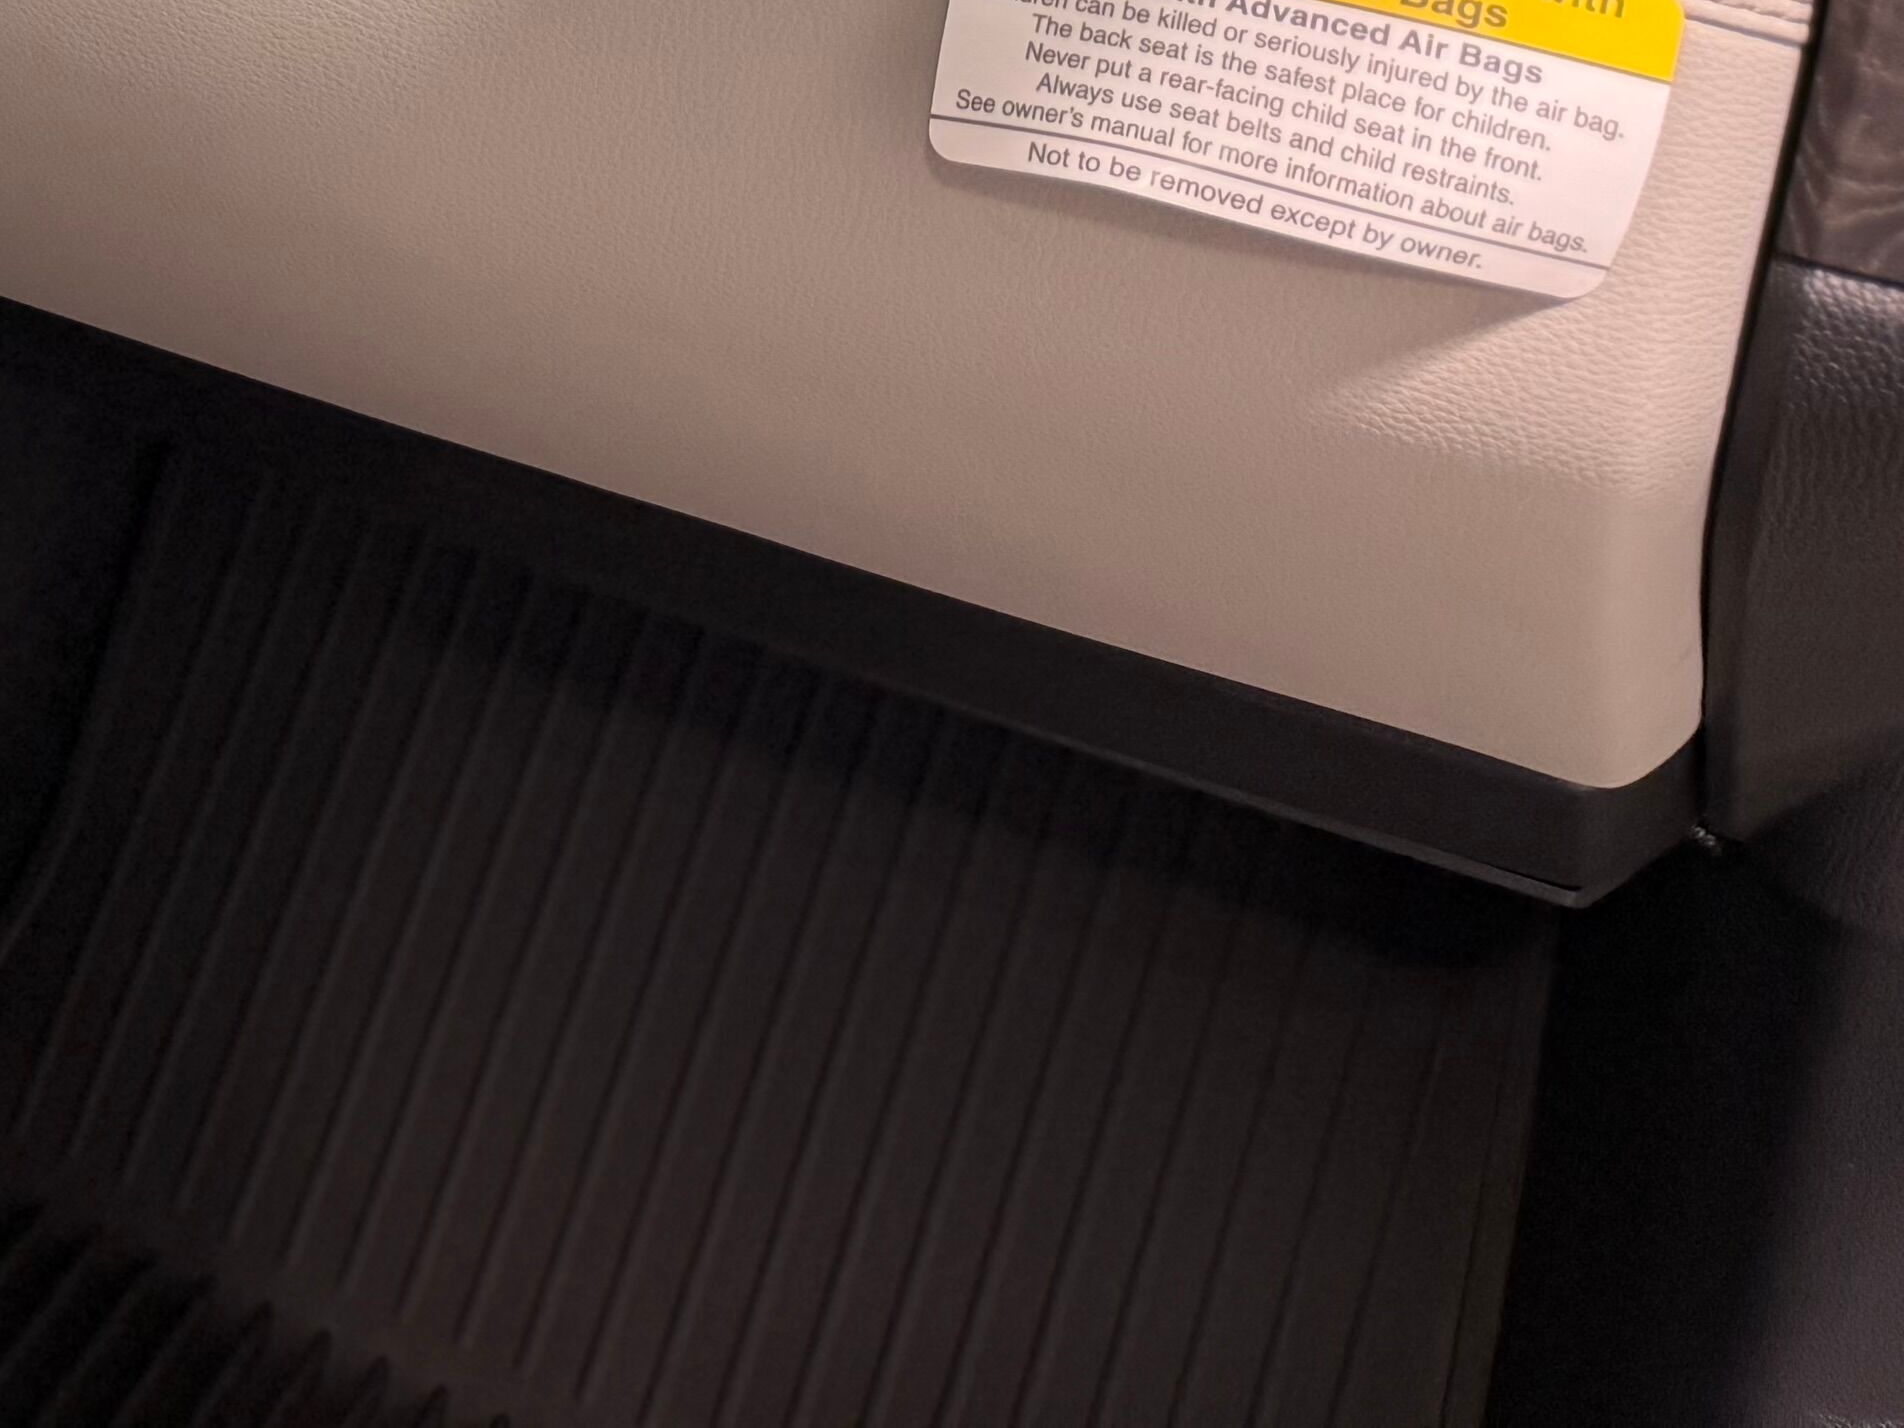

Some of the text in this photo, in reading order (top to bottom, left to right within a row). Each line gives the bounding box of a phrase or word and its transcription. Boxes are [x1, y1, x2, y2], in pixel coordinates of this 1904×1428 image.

[1026, 41, 1542, 181] Never put a rear-facing child seat in the front.
[1033, 13, 1551, 151] The back seat is the safest place for children.
[1122, 1, 1150, 24] be
[1158, 7, 1217, 37] killed
[1223, 25, 1247, 43] or
[1254, 30, 1360, 73] seriously
[1367, 53, 1448, 91] injured
[1455, 75, 1484, 105] by
[1491, 85, 1528, 113] the
[1535, 99, 1568, 122] air
[1574, 106, 1624, 141] bag.
[1398, 30, 1448, 59] Air
[1459, 42, 1543, 85] Bags
[956, 89, 1588, 254] See owner's manual for more information about air bags.
[1028, 142, 1482, 269] Not to be removed except by owner.
[1036, 72, 1514, 205] Always use seat belts and child restraints.
